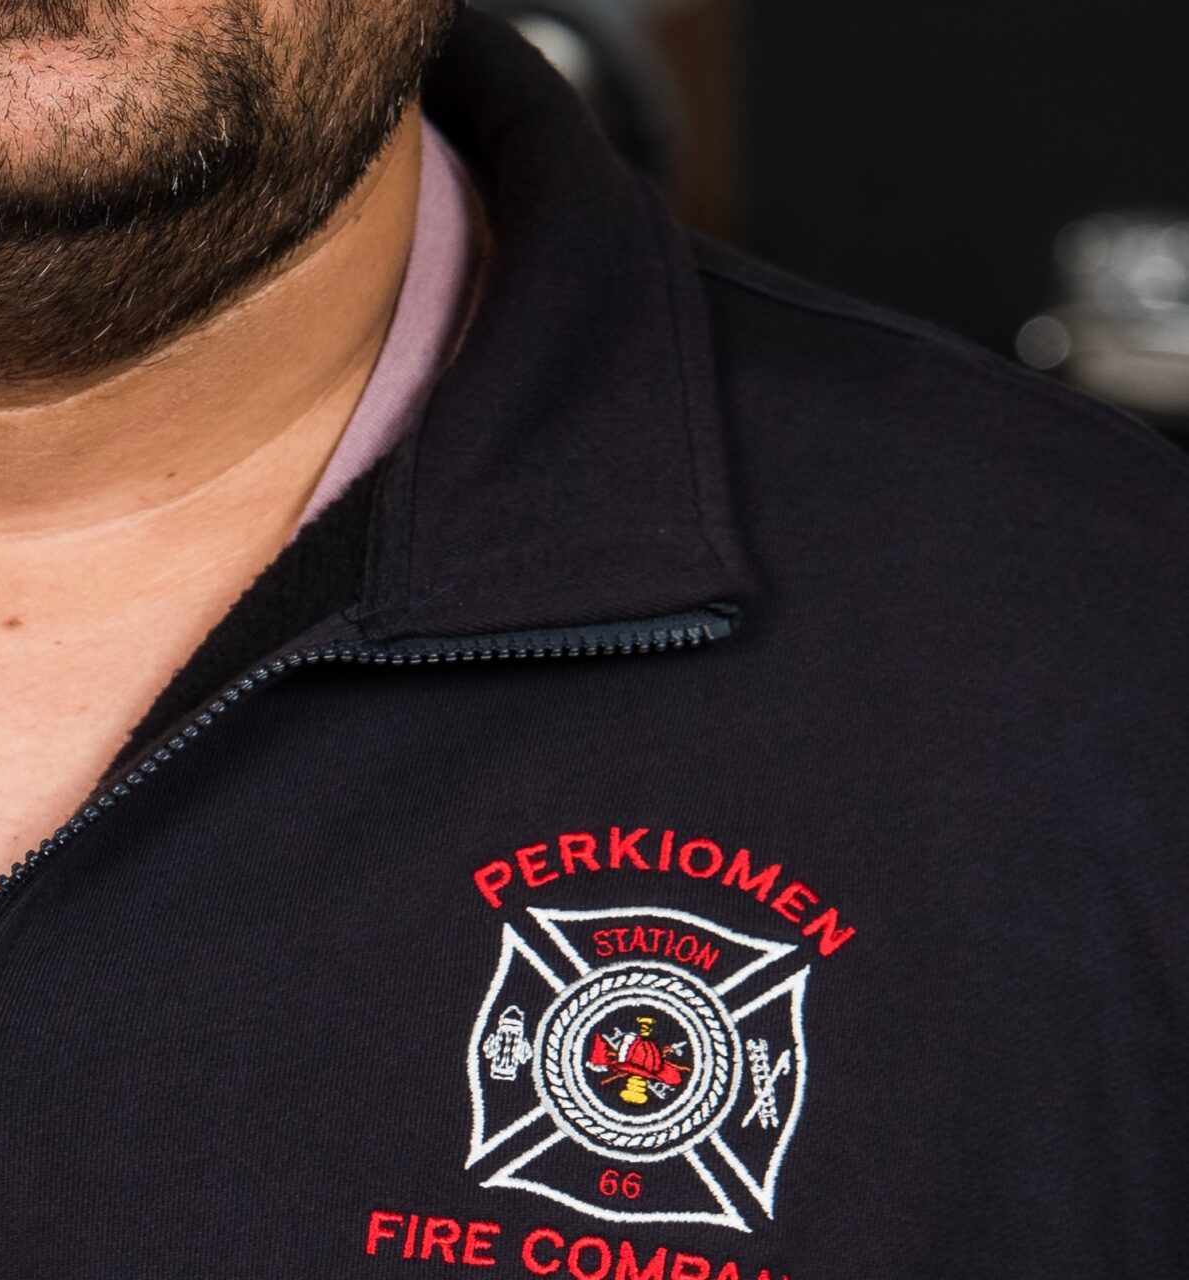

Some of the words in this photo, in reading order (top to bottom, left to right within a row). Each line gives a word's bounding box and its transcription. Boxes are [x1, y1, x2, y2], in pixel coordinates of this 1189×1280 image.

[473, 826, 856, 957] PERKIOMEN
[592, 925, 720, 971] STATION
[598, 1169, 642, 1199] 66
[365, 1211, 501, 1266] FIRE
[521, 1227, 792, 1280] COMP
